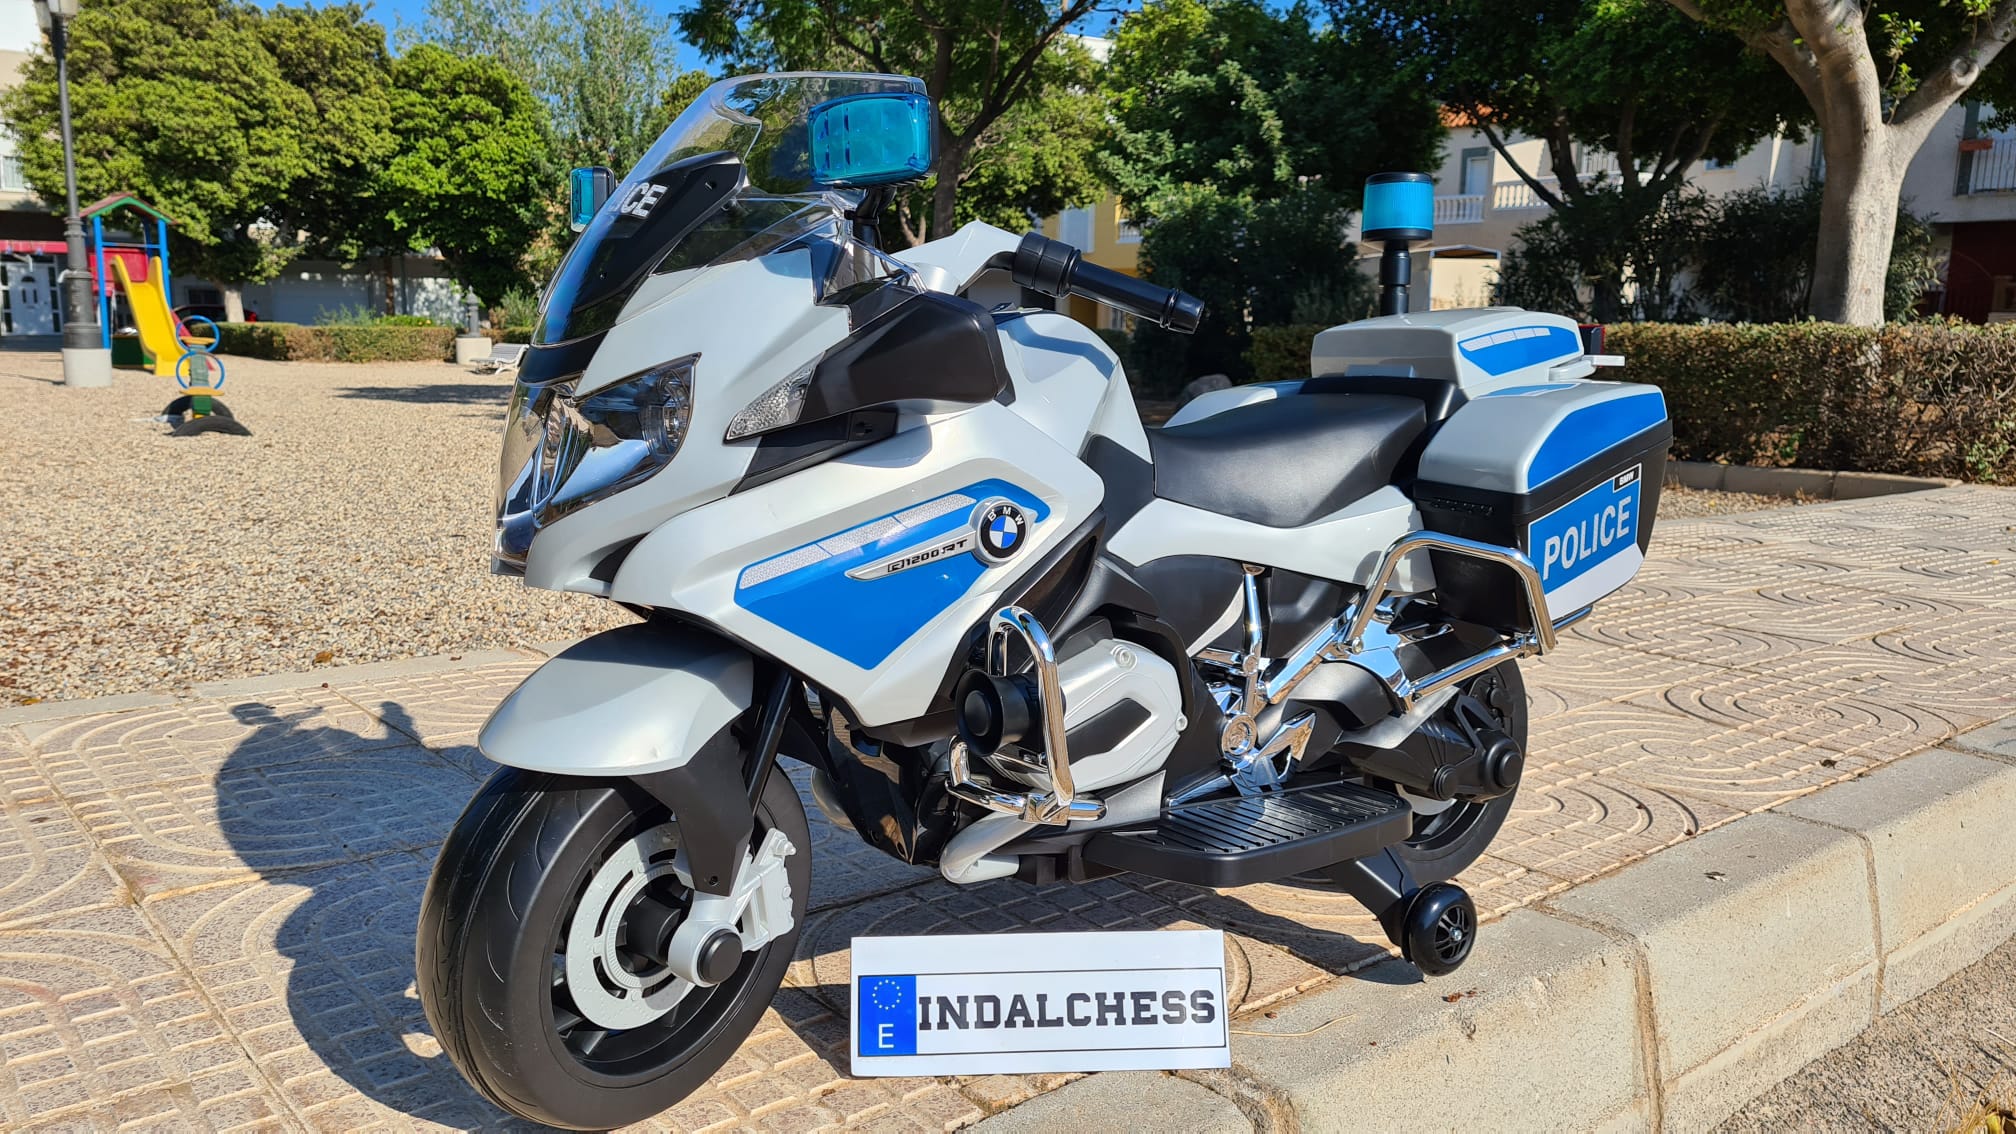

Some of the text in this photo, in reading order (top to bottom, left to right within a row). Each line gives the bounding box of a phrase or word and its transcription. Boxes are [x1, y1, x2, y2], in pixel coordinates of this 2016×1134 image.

[1619, 470, 1635, 486] BMW
[987, 506, 1025, 525] BMW
[1543, 495, 1632, 581] POLICE
[918, 989, 1215, 1031] INDALCHESS
[878, 1023, 895, 1049] E
